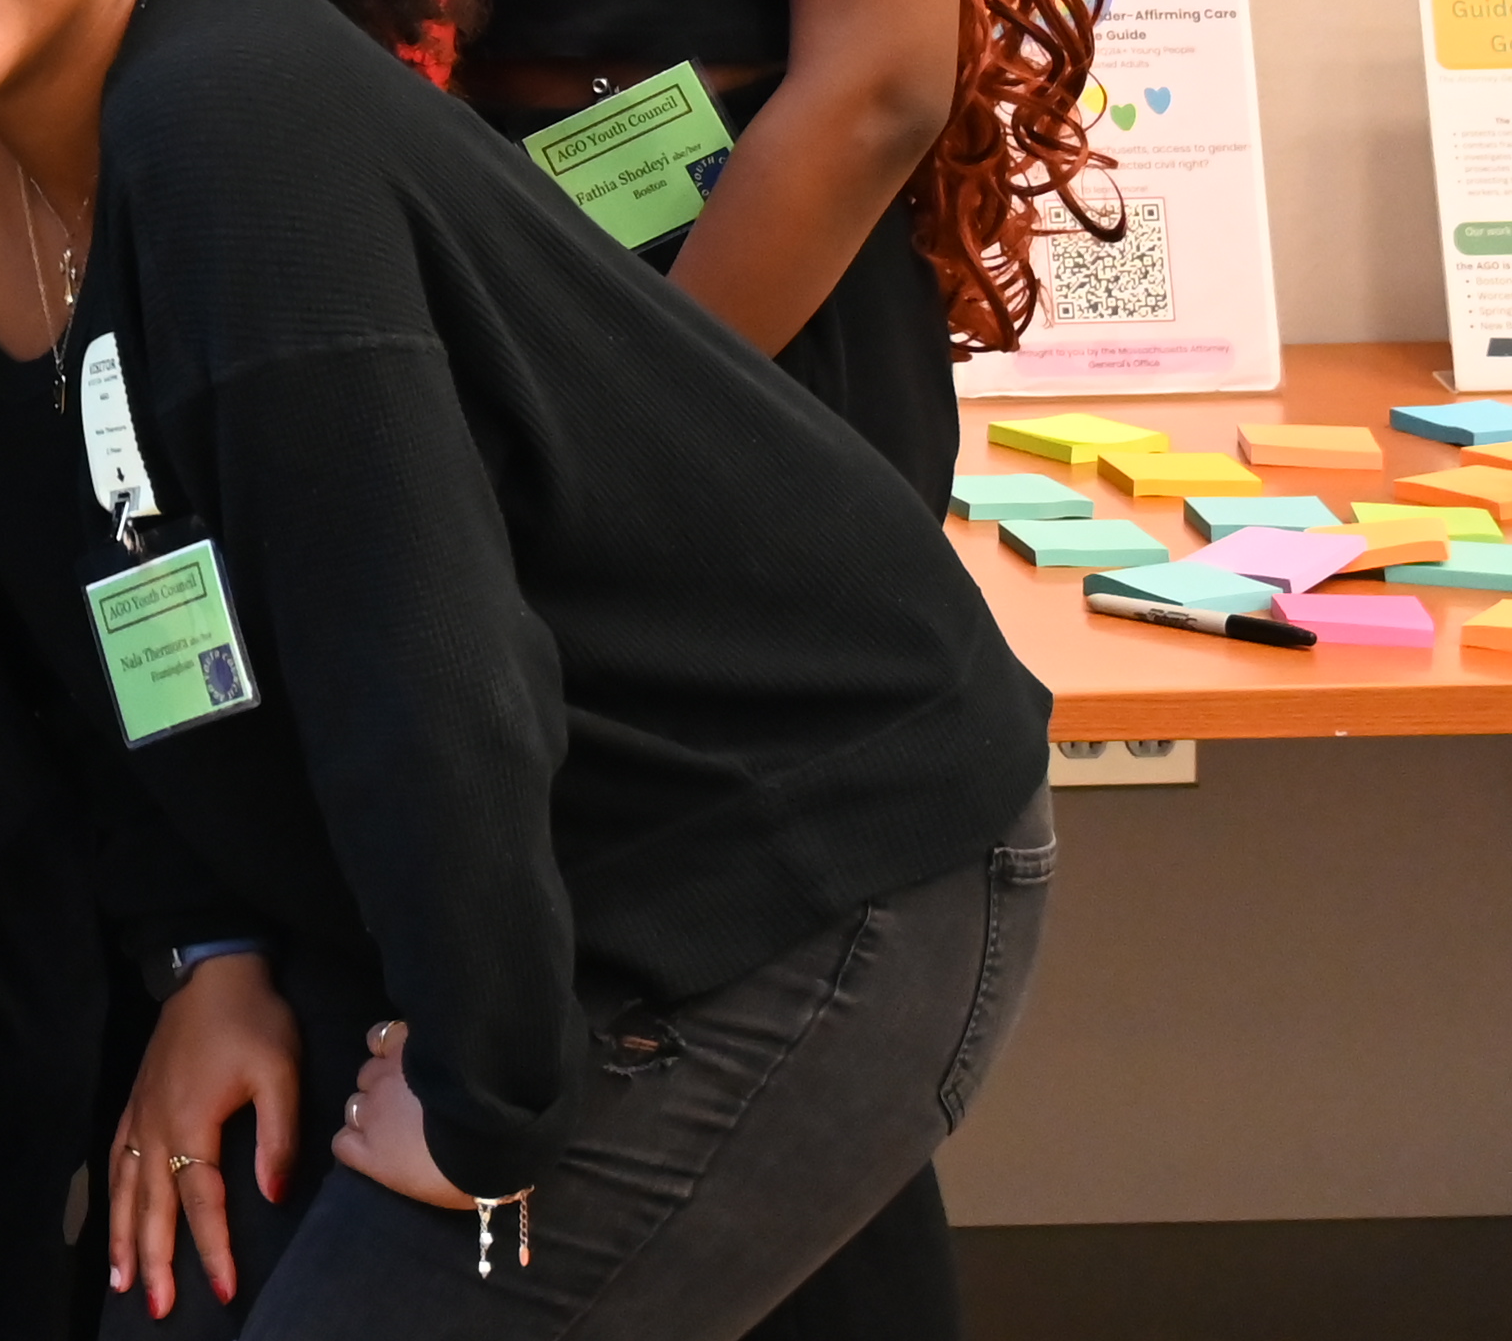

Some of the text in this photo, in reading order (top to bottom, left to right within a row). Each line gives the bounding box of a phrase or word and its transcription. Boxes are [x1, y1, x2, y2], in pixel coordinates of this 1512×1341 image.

[1105, 8, 1237, 23] der-Affirming Care
[1106, 30, 1147, 41] Guide
[557, 95, 679, 163] AGO Youth Council
[575, 180, 618, 207] Fathia
[617, 152, 671, 186] Shodeyi
[632, 179, 668, 200] Boston
[109, 572, 197, 621] AGO Youth Council
